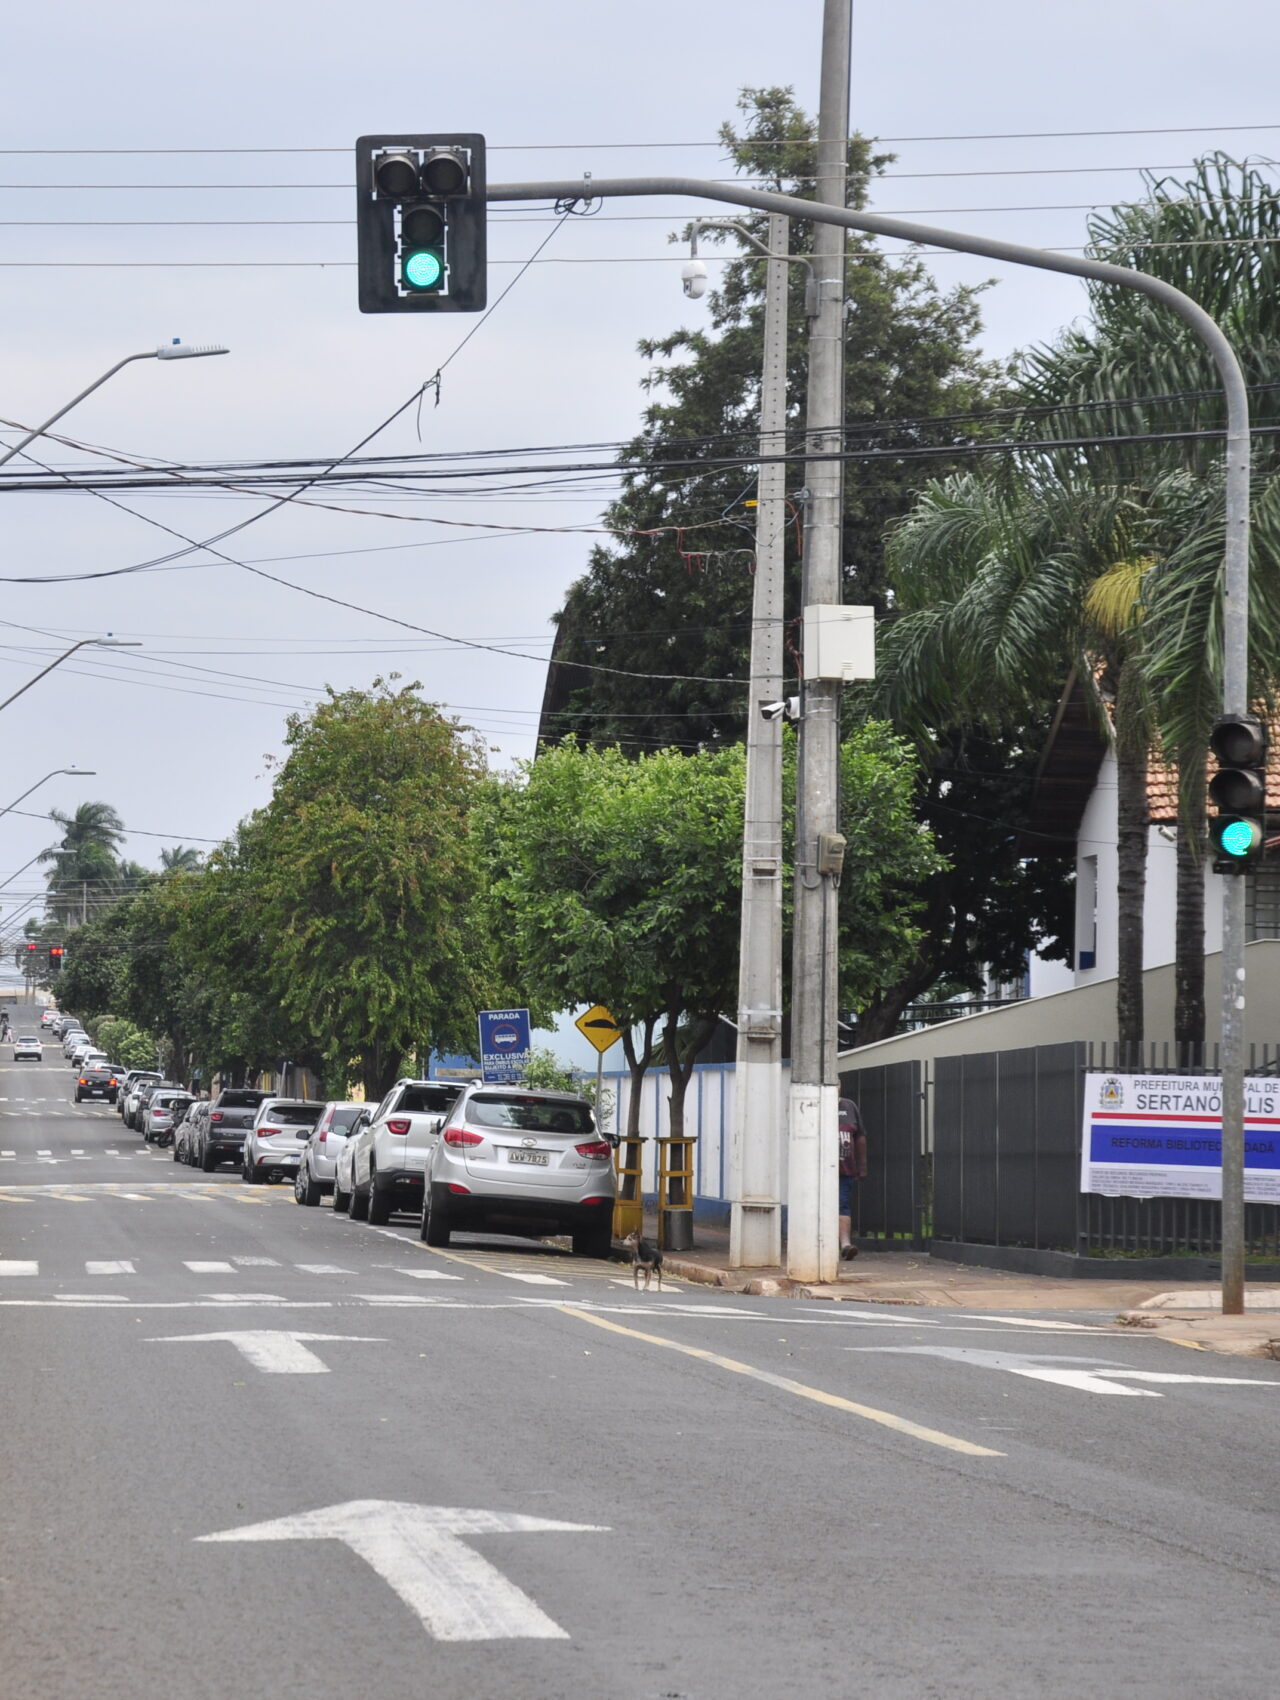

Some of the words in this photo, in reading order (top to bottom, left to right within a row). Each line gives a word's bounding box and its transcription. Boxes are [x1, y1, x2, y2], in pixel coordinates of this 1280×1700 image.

[488, 1012, 520, 1021] PARADA
[483, 1052, 529, 1061] EXCLUSIVA
[1134, 1080, 1200, 1091] PREFEITURA
[1203, 1081, 1261, 1093] MUPAL
[1264, 1083, 1279, 1093] DE
[1136, 1092, 1275, 1114] SERTANÓLIS
[1111, 1137, 1163, 1149] REFORMA
[1166, 1140, 1224, 1152] BIBLIOTEC
